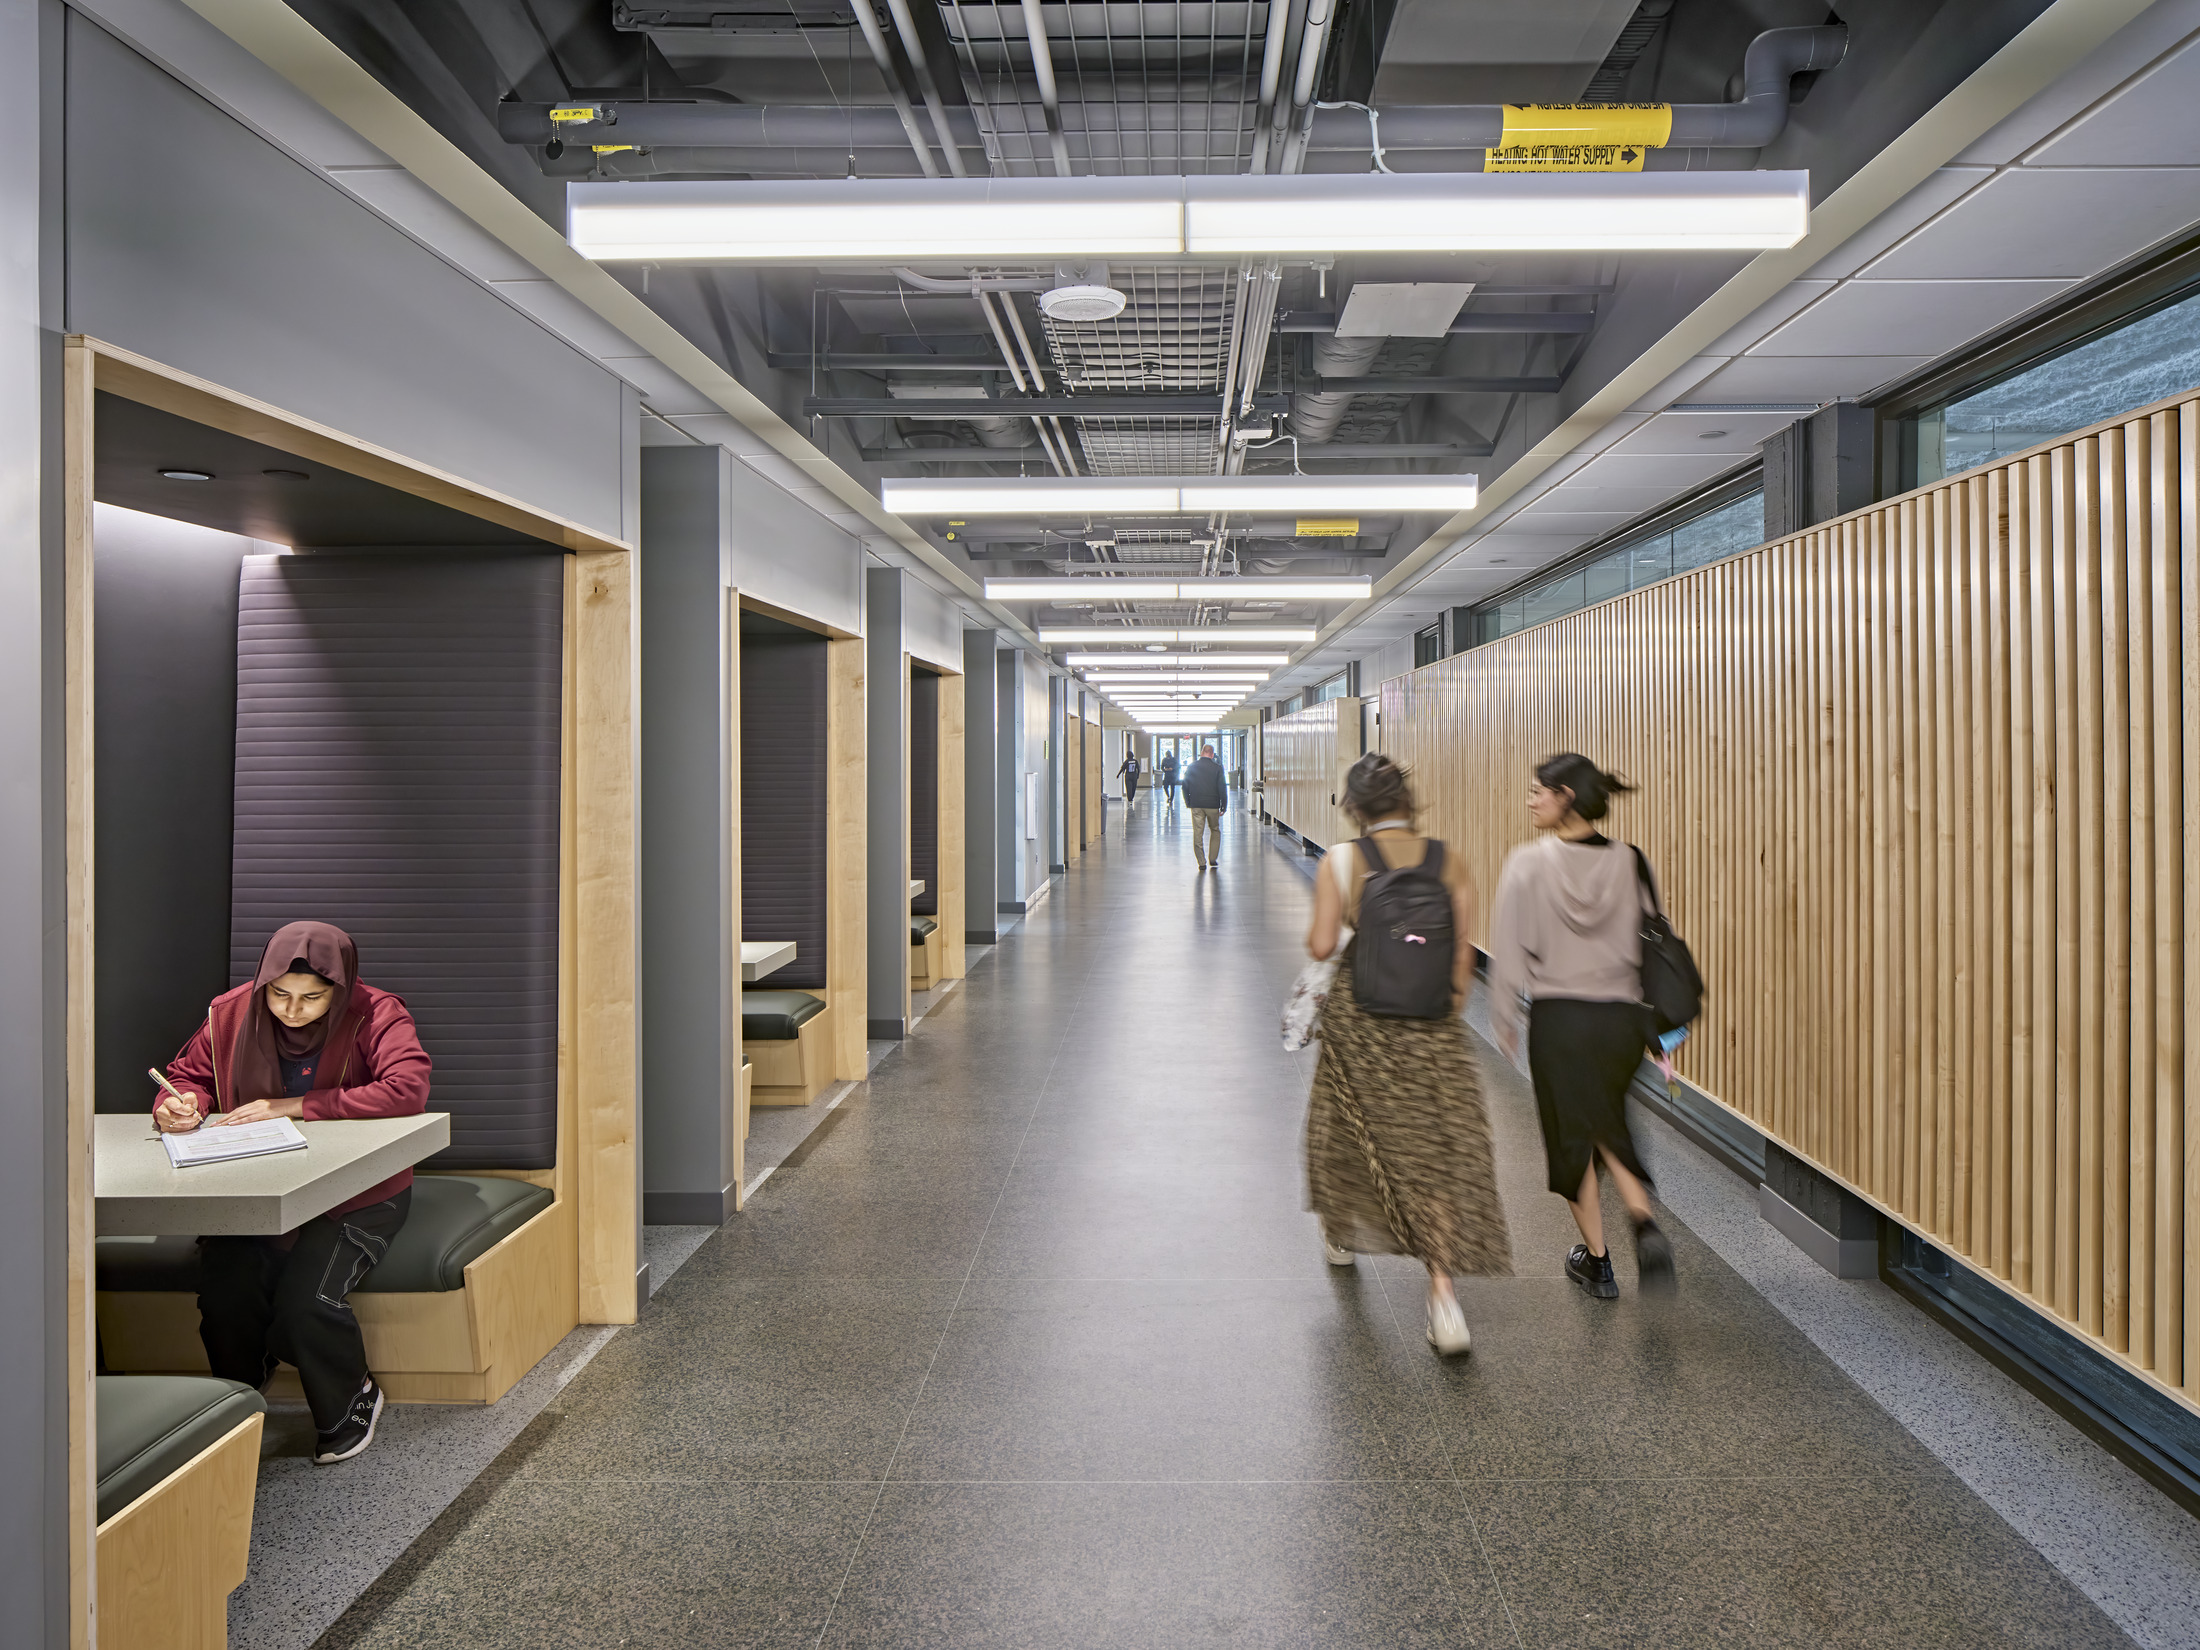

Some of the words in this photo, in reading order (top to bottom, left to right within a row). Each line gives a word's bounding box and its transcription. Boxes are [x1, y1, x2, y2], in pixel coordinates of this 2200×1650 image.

[1491, 148, 1528, 165] HEATING
[1531, 148, 1549, 165] HOT
[1552, 148, 1580, 165] WATER
[1583, 148, 1616, 165] SUPPLY
